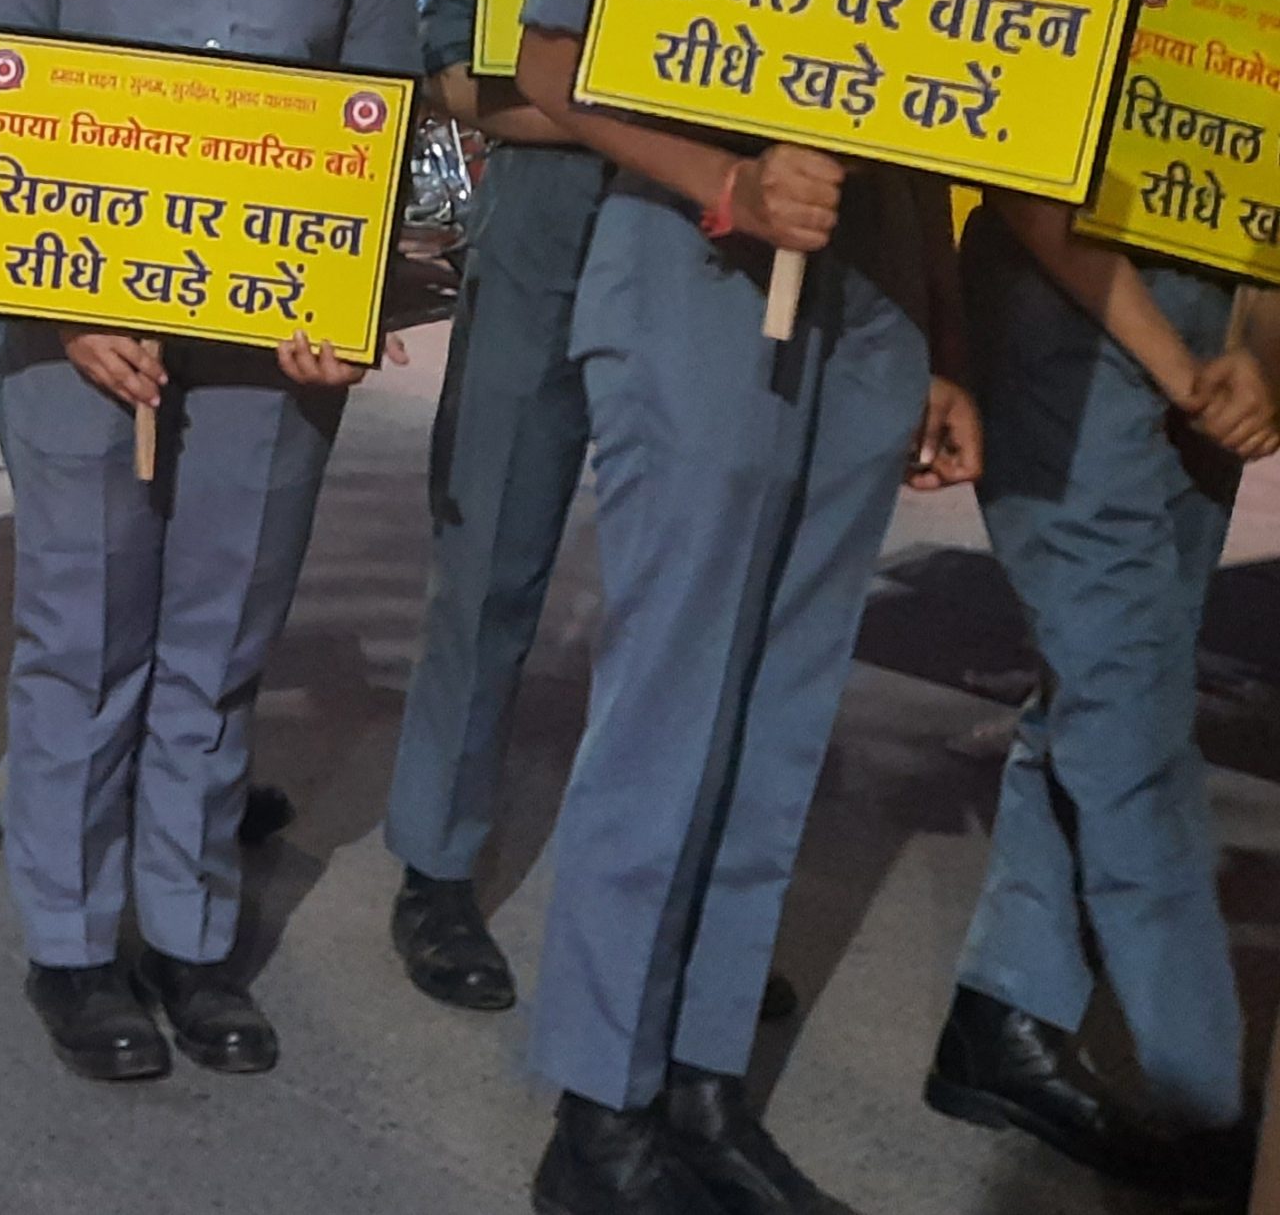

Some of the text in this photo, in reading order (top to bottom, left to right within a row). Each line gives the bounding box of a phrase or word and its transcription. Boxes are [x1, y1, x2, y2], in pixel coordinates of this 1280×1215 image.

[653, 16, 1009, 142] सीधे खड़े करें.
[1205, 40, 1280, 91] जिम्मेद
[70, 111, 192, 159] जिम्मेदार
[201, 134, 316, 172] नागरिक
[324, 144, 375, 182] बनें.
[1123, 74, 1265, 163] सिग्नल
[164, 192, 227, 238] पर
[243, 202, 368, 257] वाहन
[1141, 160, 1226, 229] सीधे
[6, 232, 314, 323] सीधे खड़े करें.
